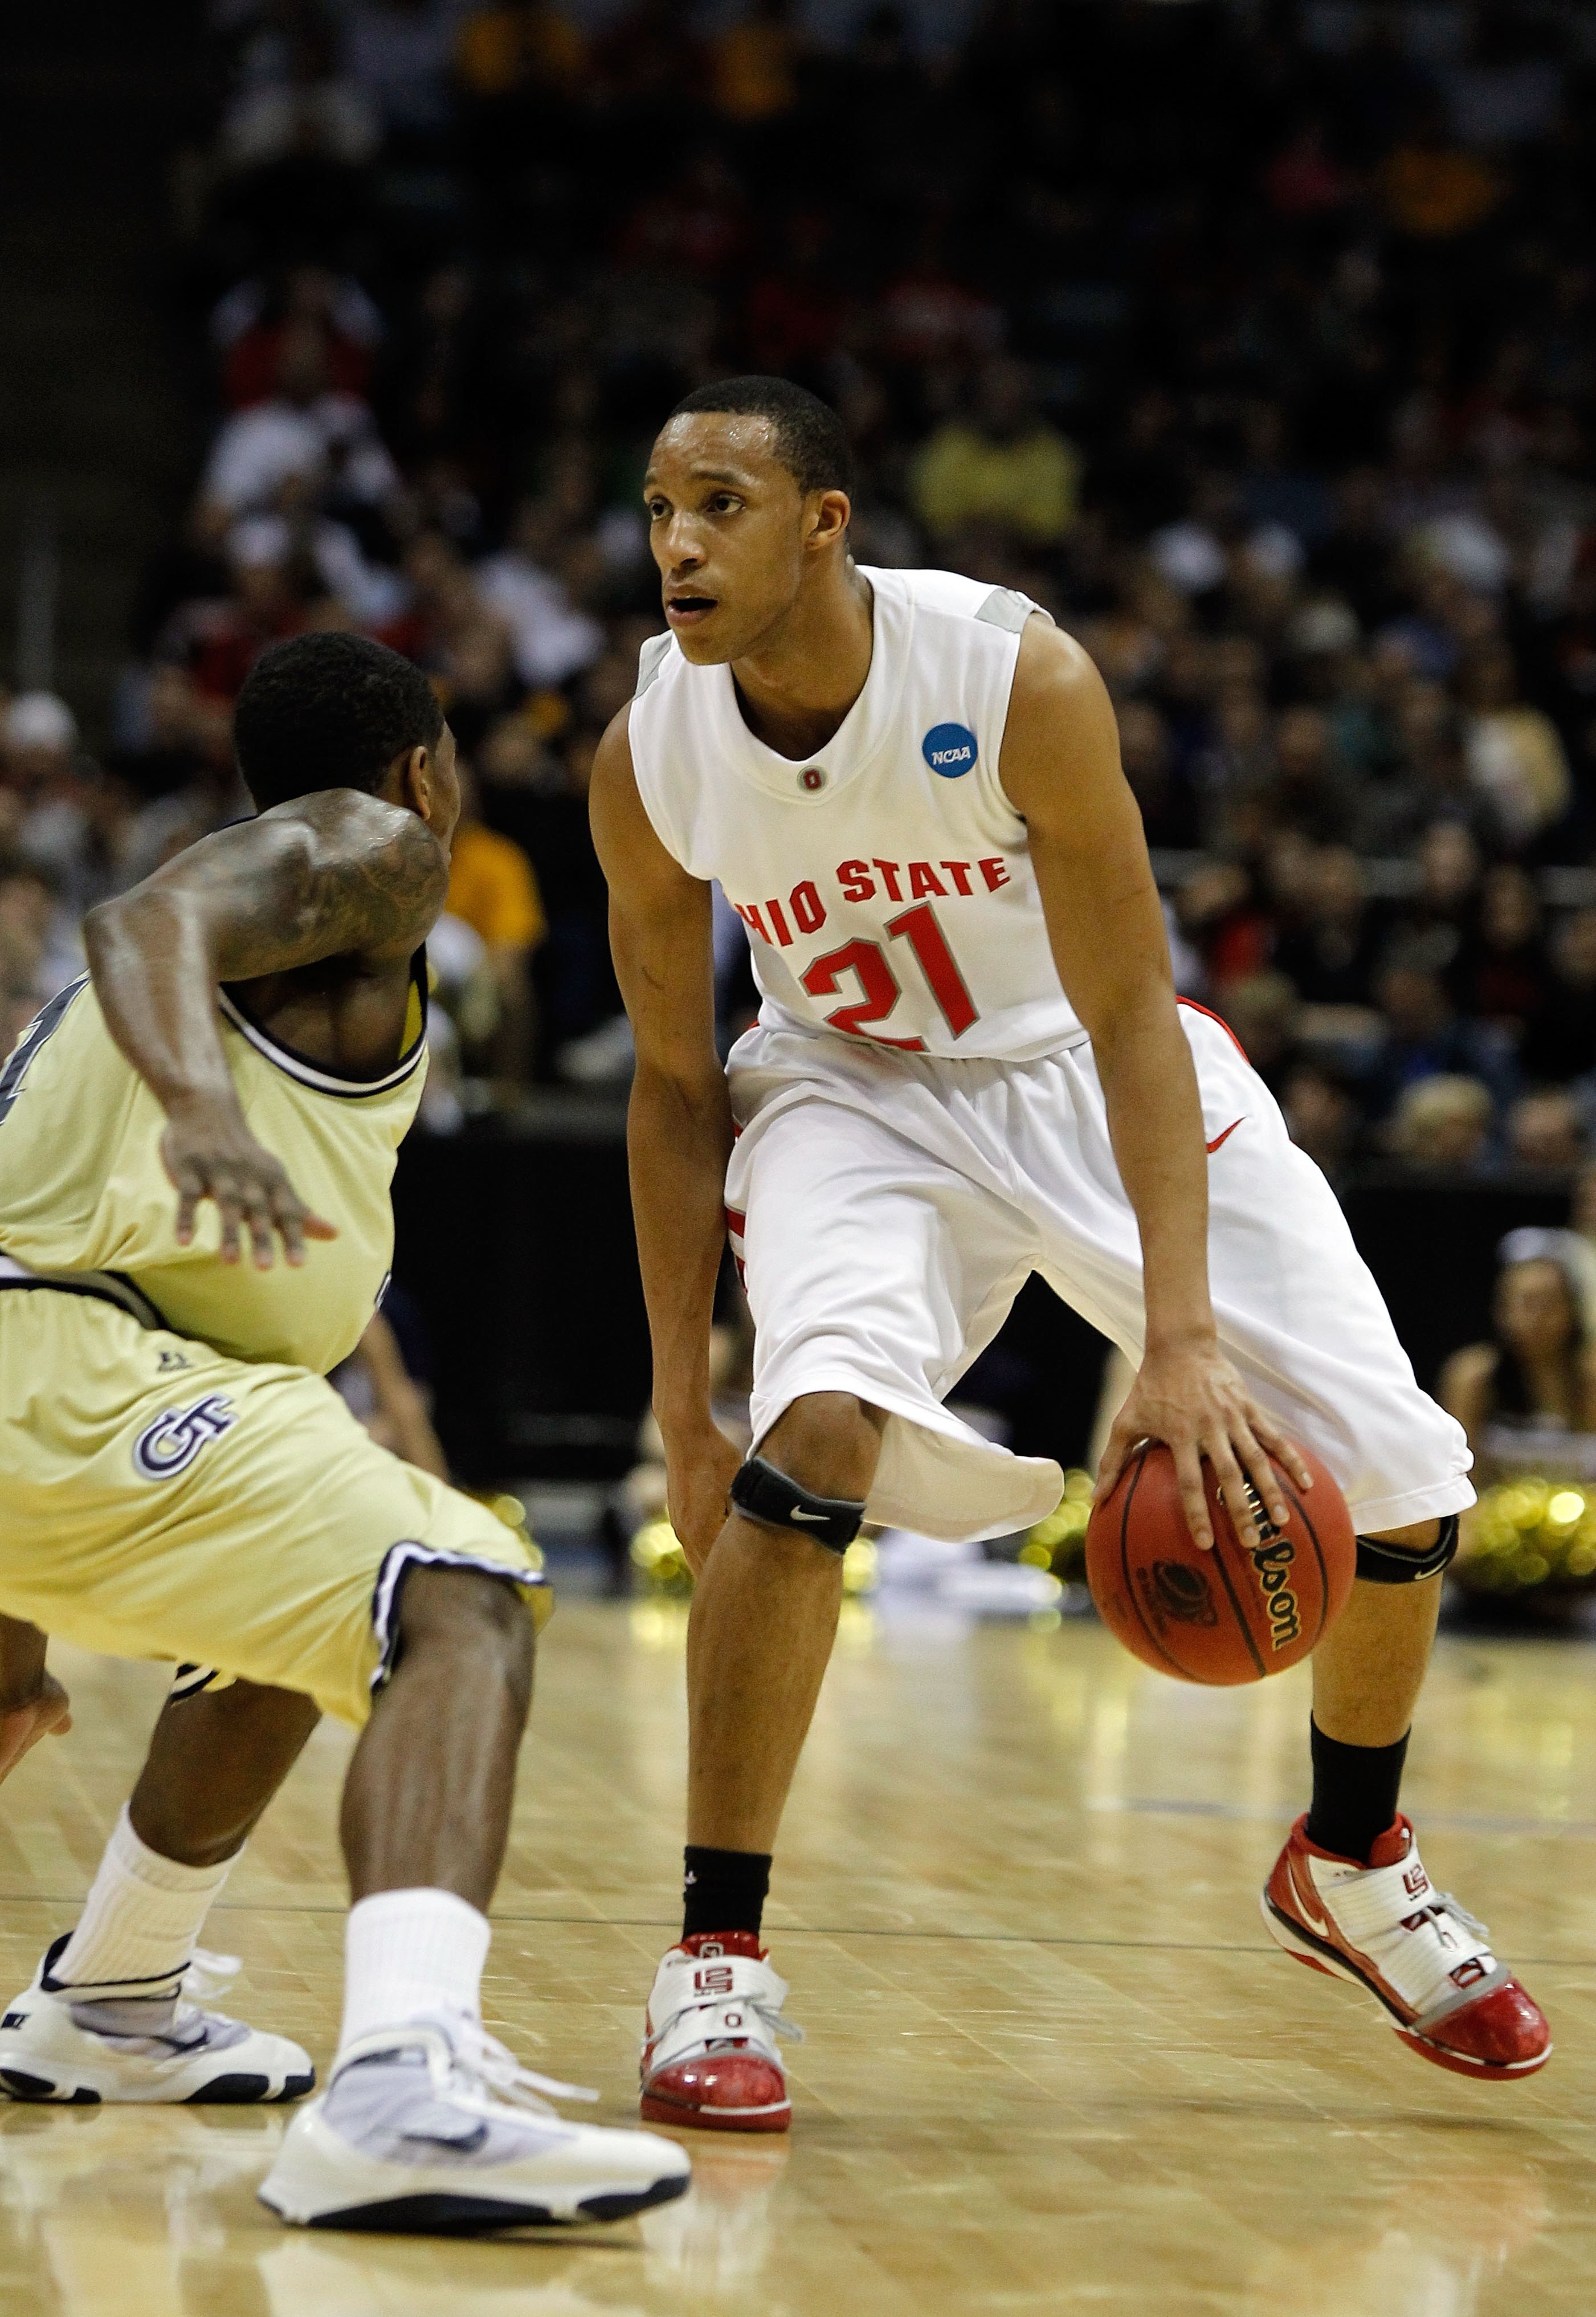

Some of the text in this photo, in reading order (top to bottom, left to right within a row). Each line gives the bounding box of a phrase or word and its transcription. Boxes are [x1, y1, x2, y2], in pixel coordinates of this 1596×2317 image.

[932, 745, 971, 765] NCAA
[836, 857, 1011, 903] STATE
[798, 901, 981, 1053] 21
[133, 1394, 239, 1480] GT
